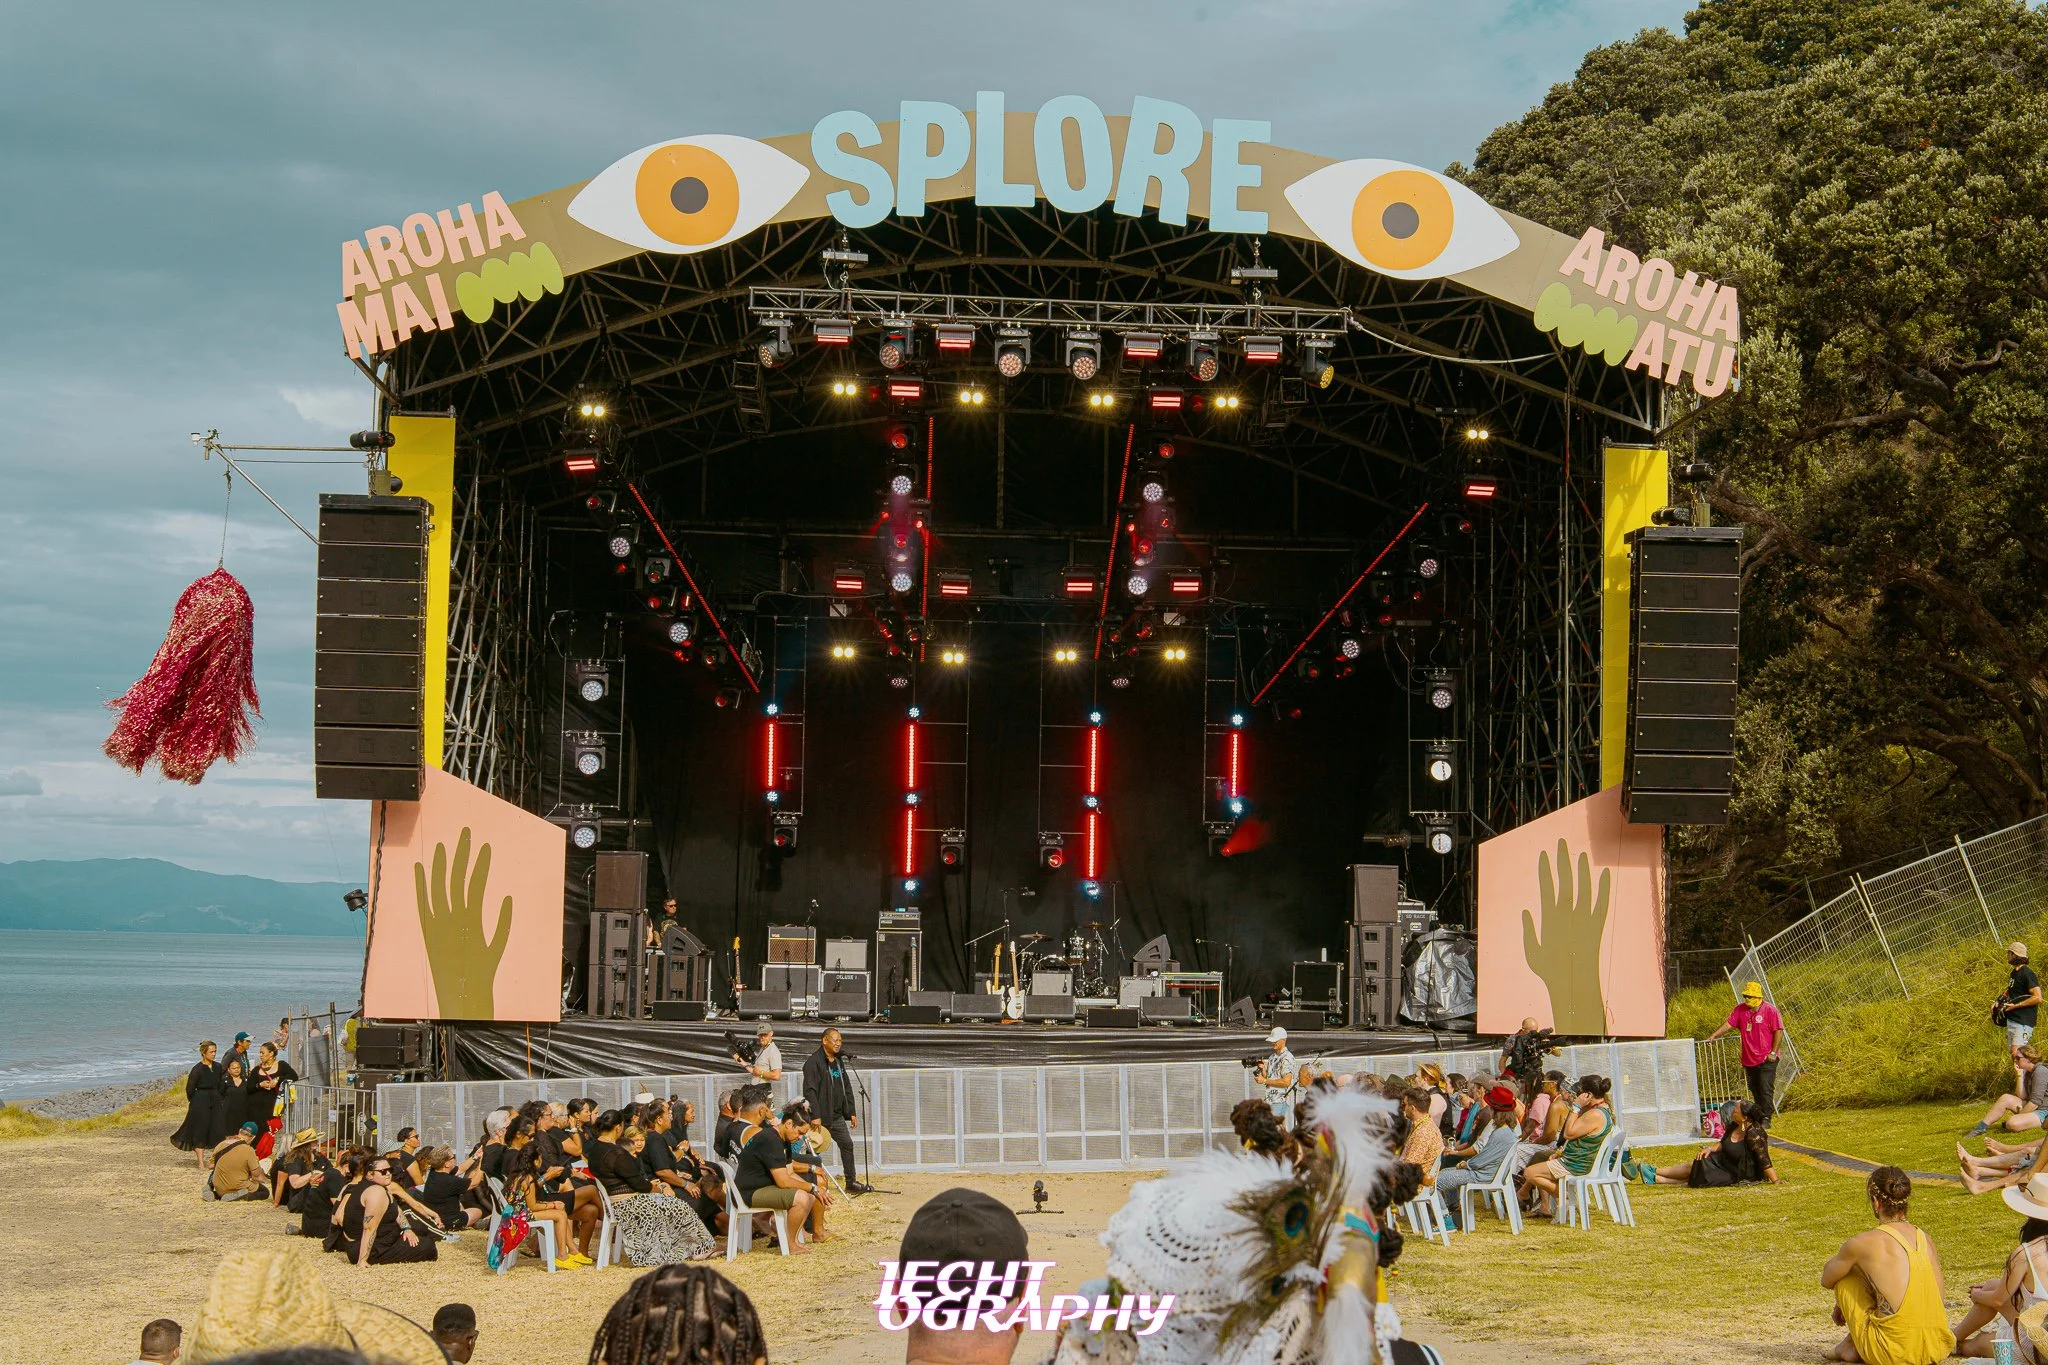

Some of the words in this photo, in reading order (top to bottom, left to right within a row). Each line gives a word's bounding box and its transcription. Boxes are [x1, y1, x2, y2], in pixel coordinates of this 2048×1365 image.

[811, 91, 1271, 233] SPLORE
[342, 190, 526, 298] AROHA
[1559, 226, 1738, 342] AROHA
[336, 273, 454, 359] MAI
[1625, 321, 1735, 398] ATU
